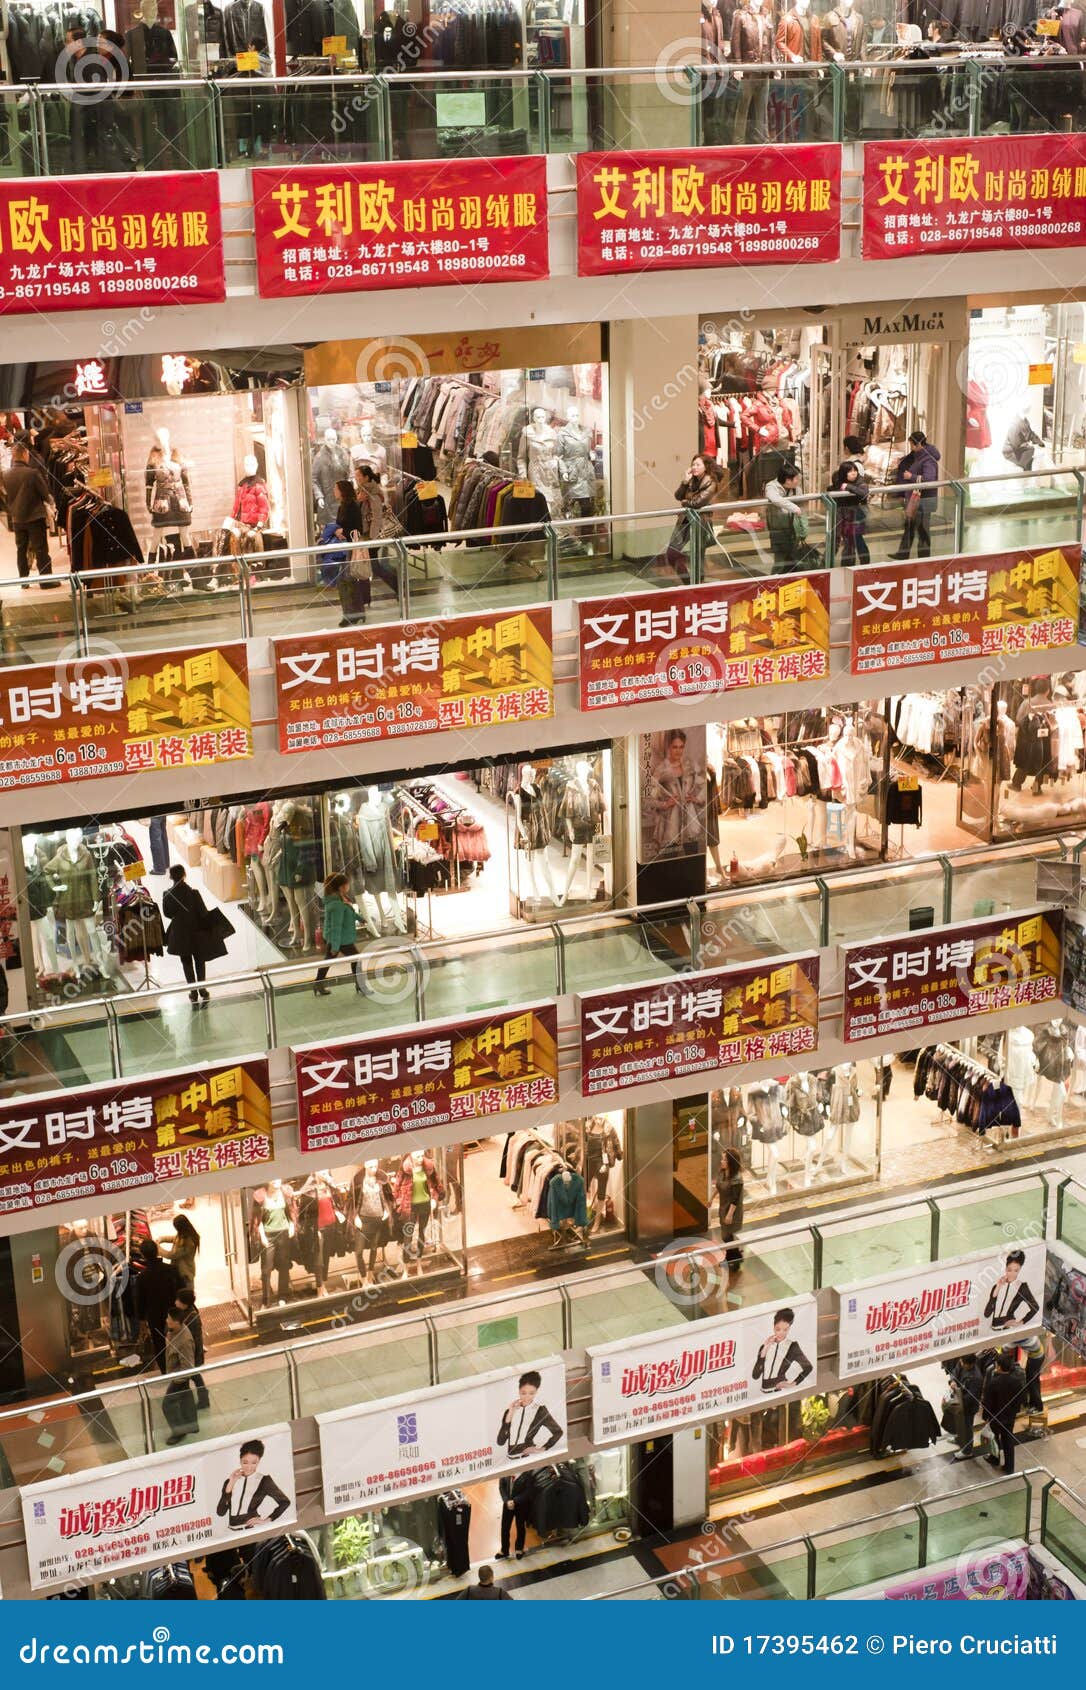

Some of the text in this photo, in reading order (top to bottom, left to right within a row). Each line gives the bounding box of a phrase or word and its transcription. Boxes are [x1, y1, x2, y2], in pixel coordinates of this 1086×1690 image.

[593, 164, 831, 220] 艾利欧 时尚羽绒服
[878, 153, 979, 206] 艾利欧
[59, 211, 210, 252] 时尚羽绒服
[272, 179, 537, 239] 艾利欧 时尚羽绒服
[1009, 222, 1080, 236] 18980800268
[437, 254, 526, 270] 18980800268
[739, 237, 819, 253] 18980800268
[98, 276, 198, 293] 18980800268
[856, 569, 988, 616] 文时特
[584, 601, 728, 650] 文时特
[983, 618, 1075, 653] 型格裤装
[280, 637, 440, 691] 文时特
[726, 651, 826, 688] 型格裤装
[440, 688, 551, 728] 型格裤装
[125, 728, 248, 771] 型格裤装
[848, 940, 974, 990] 文时特
[585, 988, 722, 1041] 文时特
[968, 976, 1056, 1015] 型格裤装
[302, 1040, 452, 1096] 文时特
[718, 1026, 815, 1069] 型格裤装
[450, 1077, 556, 1121] 型格裤装
[0, 1096, 152, 1152] 文时特
[154, 1134, 270, 1181] 型格裤装
[865, 1279, 971, 1334] 诚邀加盟
[621, 1339, 736, 1397] 诚邀加盟
[58, 1474, 195, 1539] 诚邀加盟
